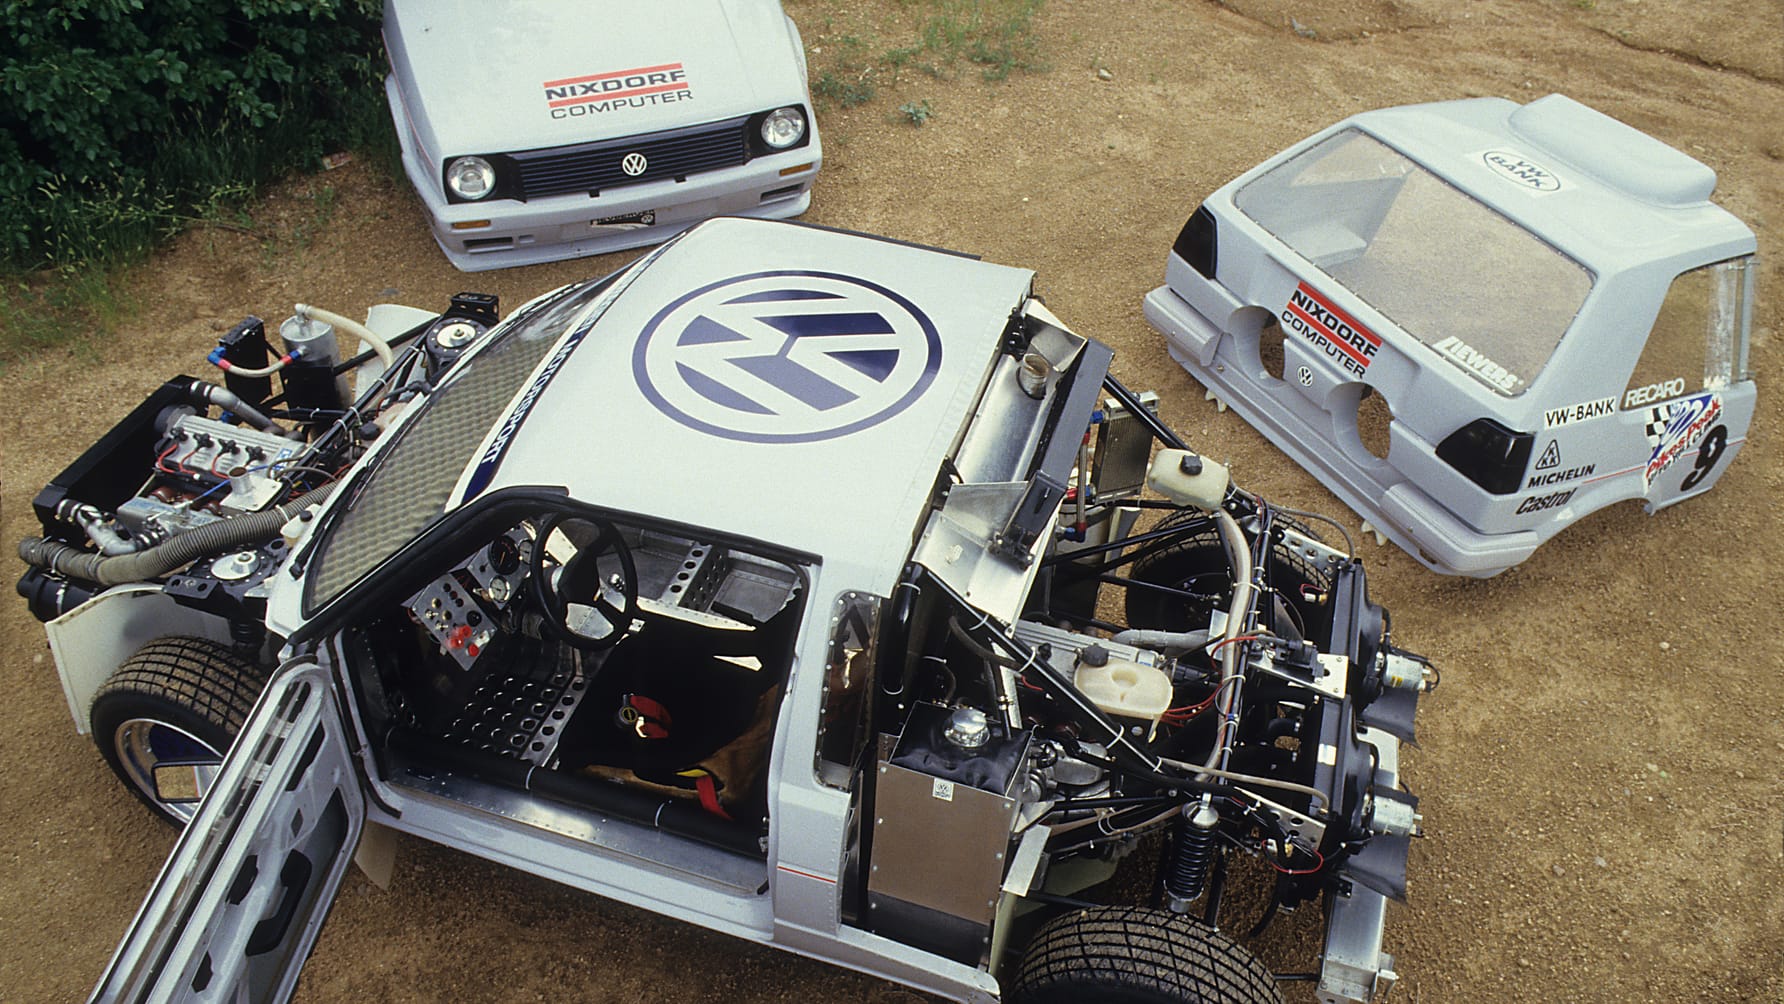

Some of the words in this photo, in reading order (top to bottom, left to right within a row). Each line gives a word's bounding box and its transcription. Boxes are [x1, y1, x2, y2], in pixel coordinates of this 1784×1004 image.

[545, 70, 686, 100] NIXDORF
[551, 90, 693, 119] COMPUTER
[1488, 156, 1546, 187] BANK
[1291, 289, 1378, 357] NIXDORF
[1281, 310, 1366, 379] COMPUTER
[481, 339, 578, 463] MOTORSPORT
[1625, 377, 1685, 408] RECARO
[1546, 398, 1615, 427] VW-BANK
[1680, 424, 1728, 492] 9
[1528, 464, 1596, 488] MICHELIN
[1516, 487, 1578, 515] Castrol
